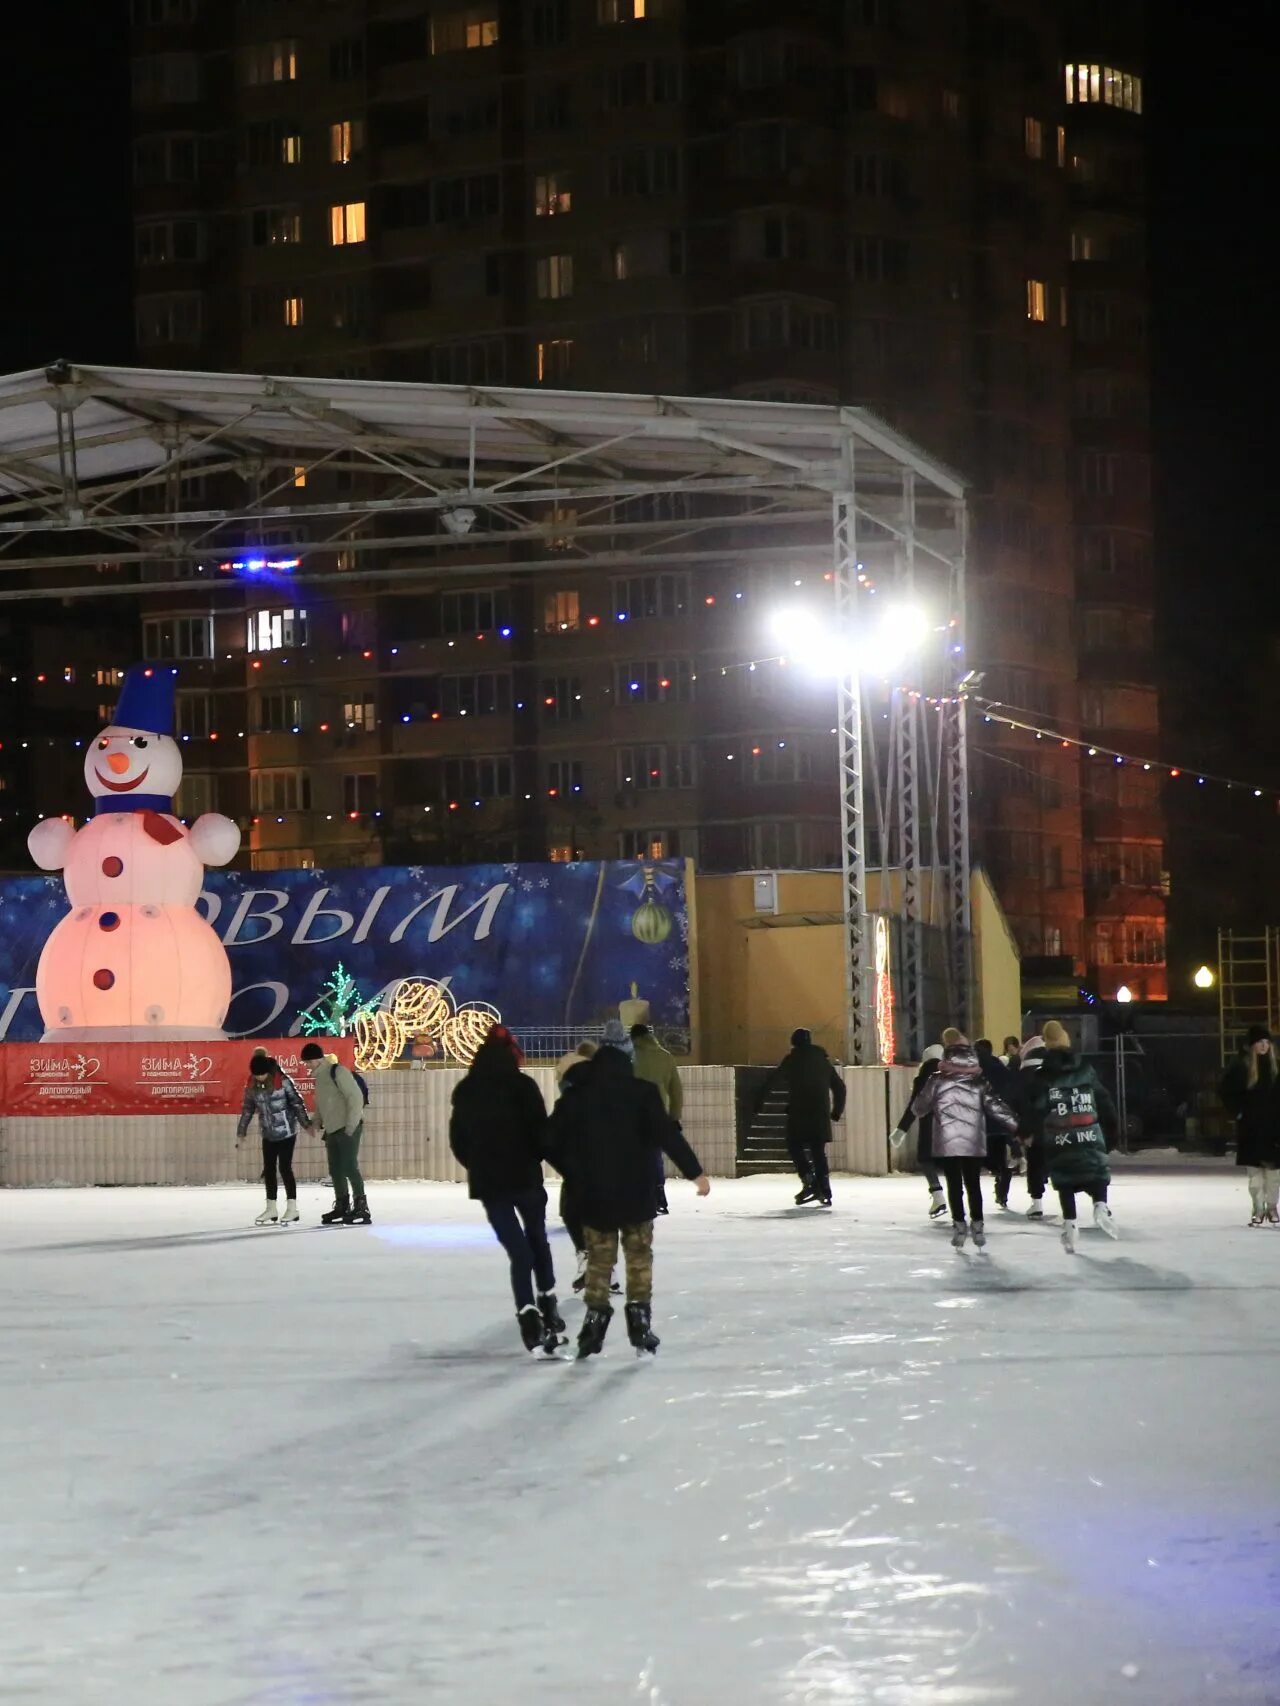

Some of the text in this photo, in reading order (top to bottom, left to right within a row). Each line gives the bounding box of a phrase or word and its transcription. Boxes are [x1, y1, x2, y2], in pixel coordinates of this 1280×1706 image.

[196, 882, 510, 946] ВЫМ
[30, 1058, 70, 1071] ЗИМА
[141, 1057, 182, 1071] ЗИМА
[39, 1086, 92, 1096] ДОЛГОПРУДНЫЙ
[152, 1085, 205, 1095] ДОЛГОПРУДНЫЙ
